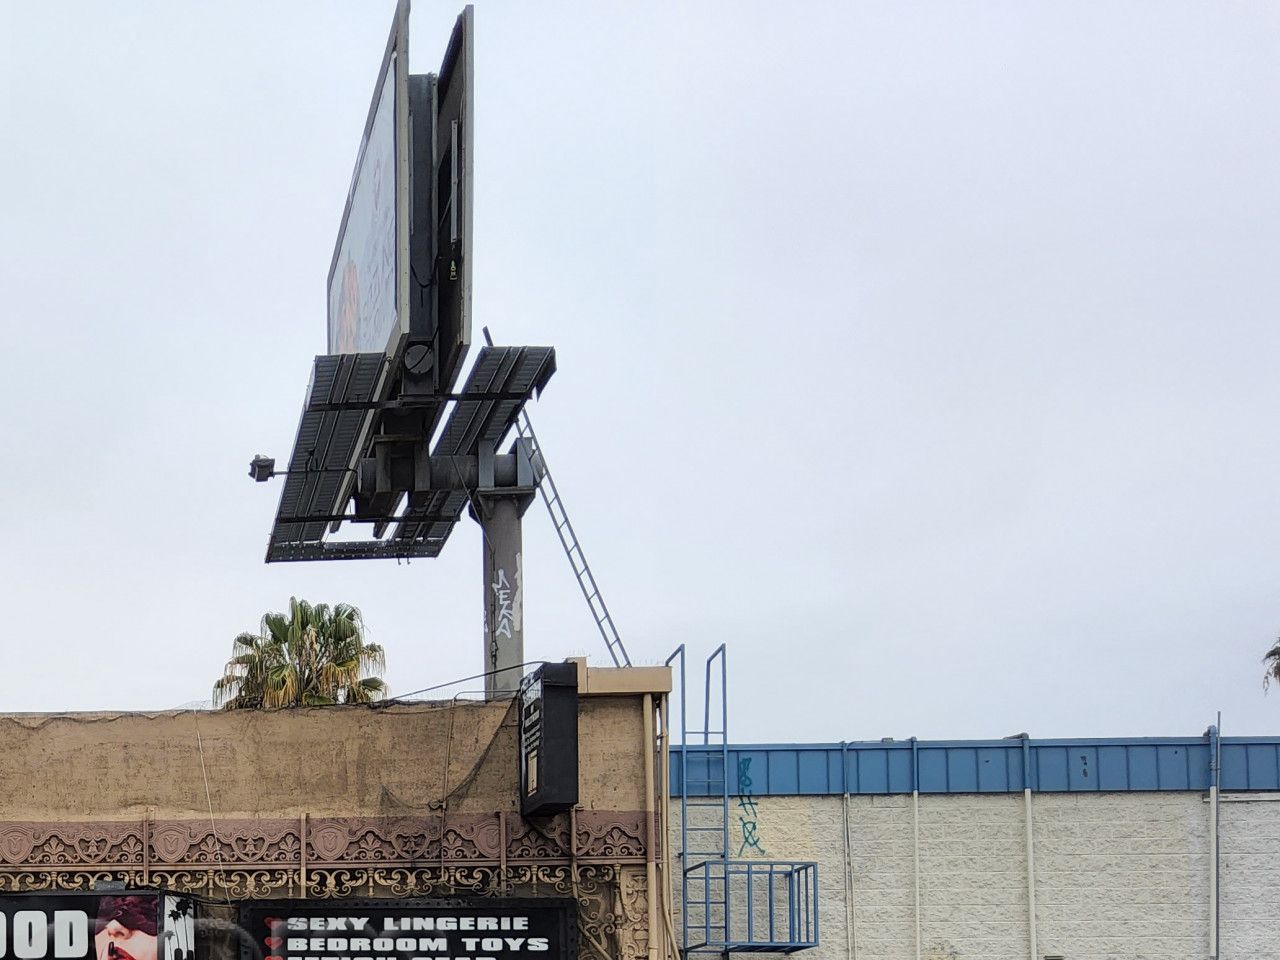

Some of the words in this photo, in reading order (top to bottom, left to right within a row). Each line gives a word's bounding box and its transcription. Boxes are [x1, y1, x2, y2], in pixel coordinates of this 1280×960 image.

[287, 917, 370, 931] SEXY
[384, 917, 529, 930] LINGERIE
[287, 938, 448, 951] BEDROOM
[461, 937, 549, 951] TOYS
